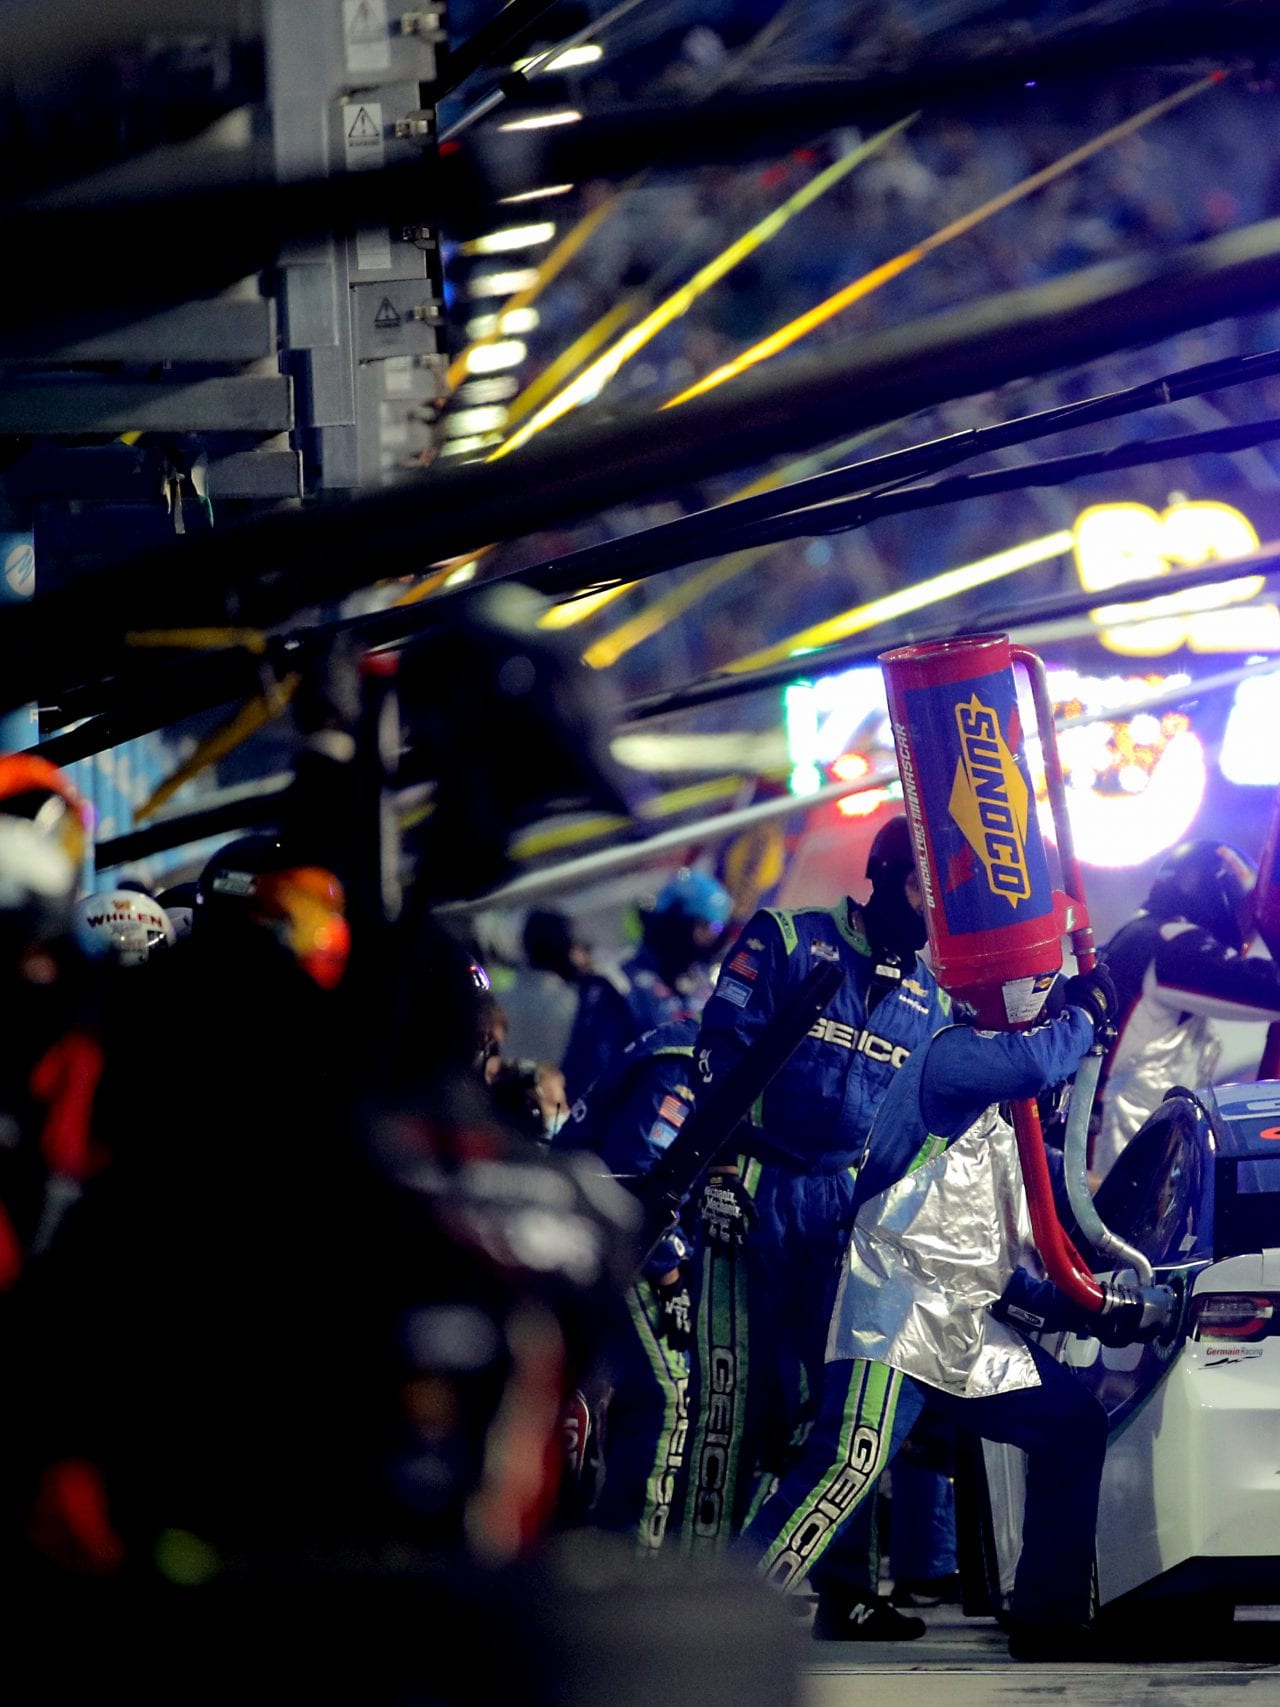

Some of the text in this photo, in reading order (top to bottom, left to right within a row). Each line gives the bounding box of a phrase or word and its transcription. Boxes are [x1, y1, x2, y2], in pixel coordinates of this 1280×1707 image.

[896, 723, 920, 804] NASCAR
[962, 706, 1027, 897] SUNOCO
[87, 913, 163, 928] WHELEN
[1206, 1347, 1240, 1356] Germain
[695, 1346, 735, 1540] GEICO
[767, 1425, 880, 1587] GEICO
